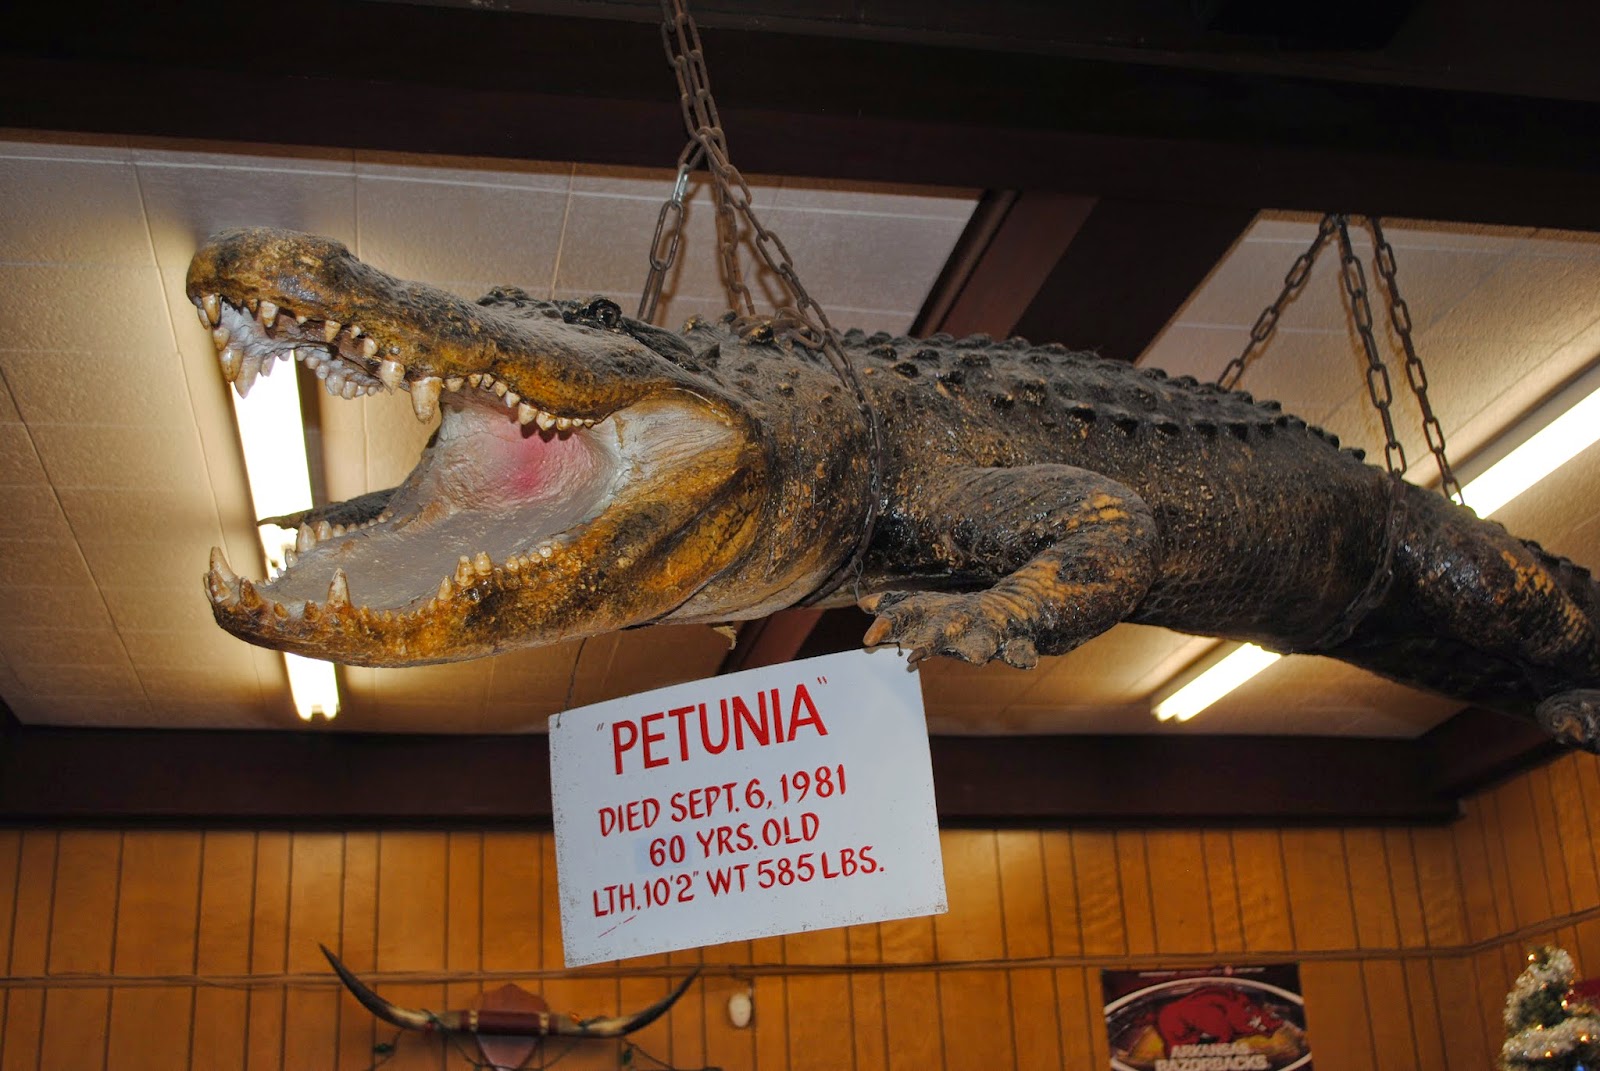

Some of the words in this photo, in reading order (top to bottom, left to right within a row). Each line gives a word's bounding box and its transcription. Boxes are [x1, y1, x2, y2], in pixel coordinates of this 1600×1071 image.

[598, 797, 661, 837] DIED
[669, 781, 741, 822] SEPT.
[780, 763, 847, 804] 1981
[649, 834, 687, 867] 60
[695, 822, 759, 859] YRS.
[762, 811, 821, 847] OLD
[705, 863, 750, 897] WT
[756, 852, 816, 890] 585
[820, 844, 886, 880] LBS.
[1154, 1054, 1270, 1071] RAZORBACKS
[1170, 1042, 1251, 1058] ARKANSAS
